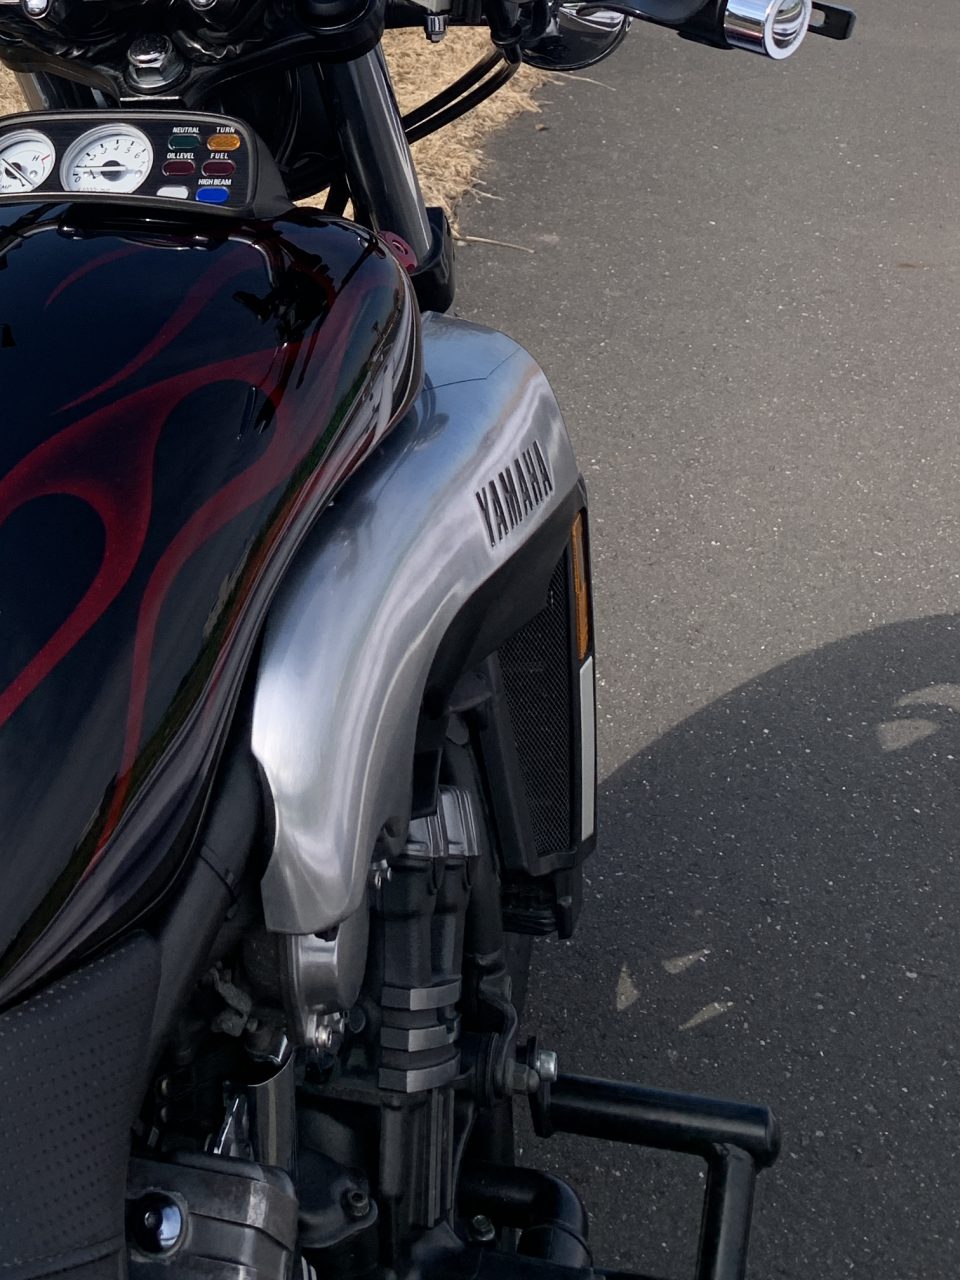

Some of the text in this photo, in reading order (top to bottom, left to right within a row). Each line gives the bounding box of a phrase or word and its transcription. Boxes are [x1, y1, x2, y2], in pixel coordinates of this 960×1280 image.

[172, 126, 200, 134] NEUTRAL
[213, 178, 232, 186] BEAM
[475, 440, 554, 548] YAMAHA
